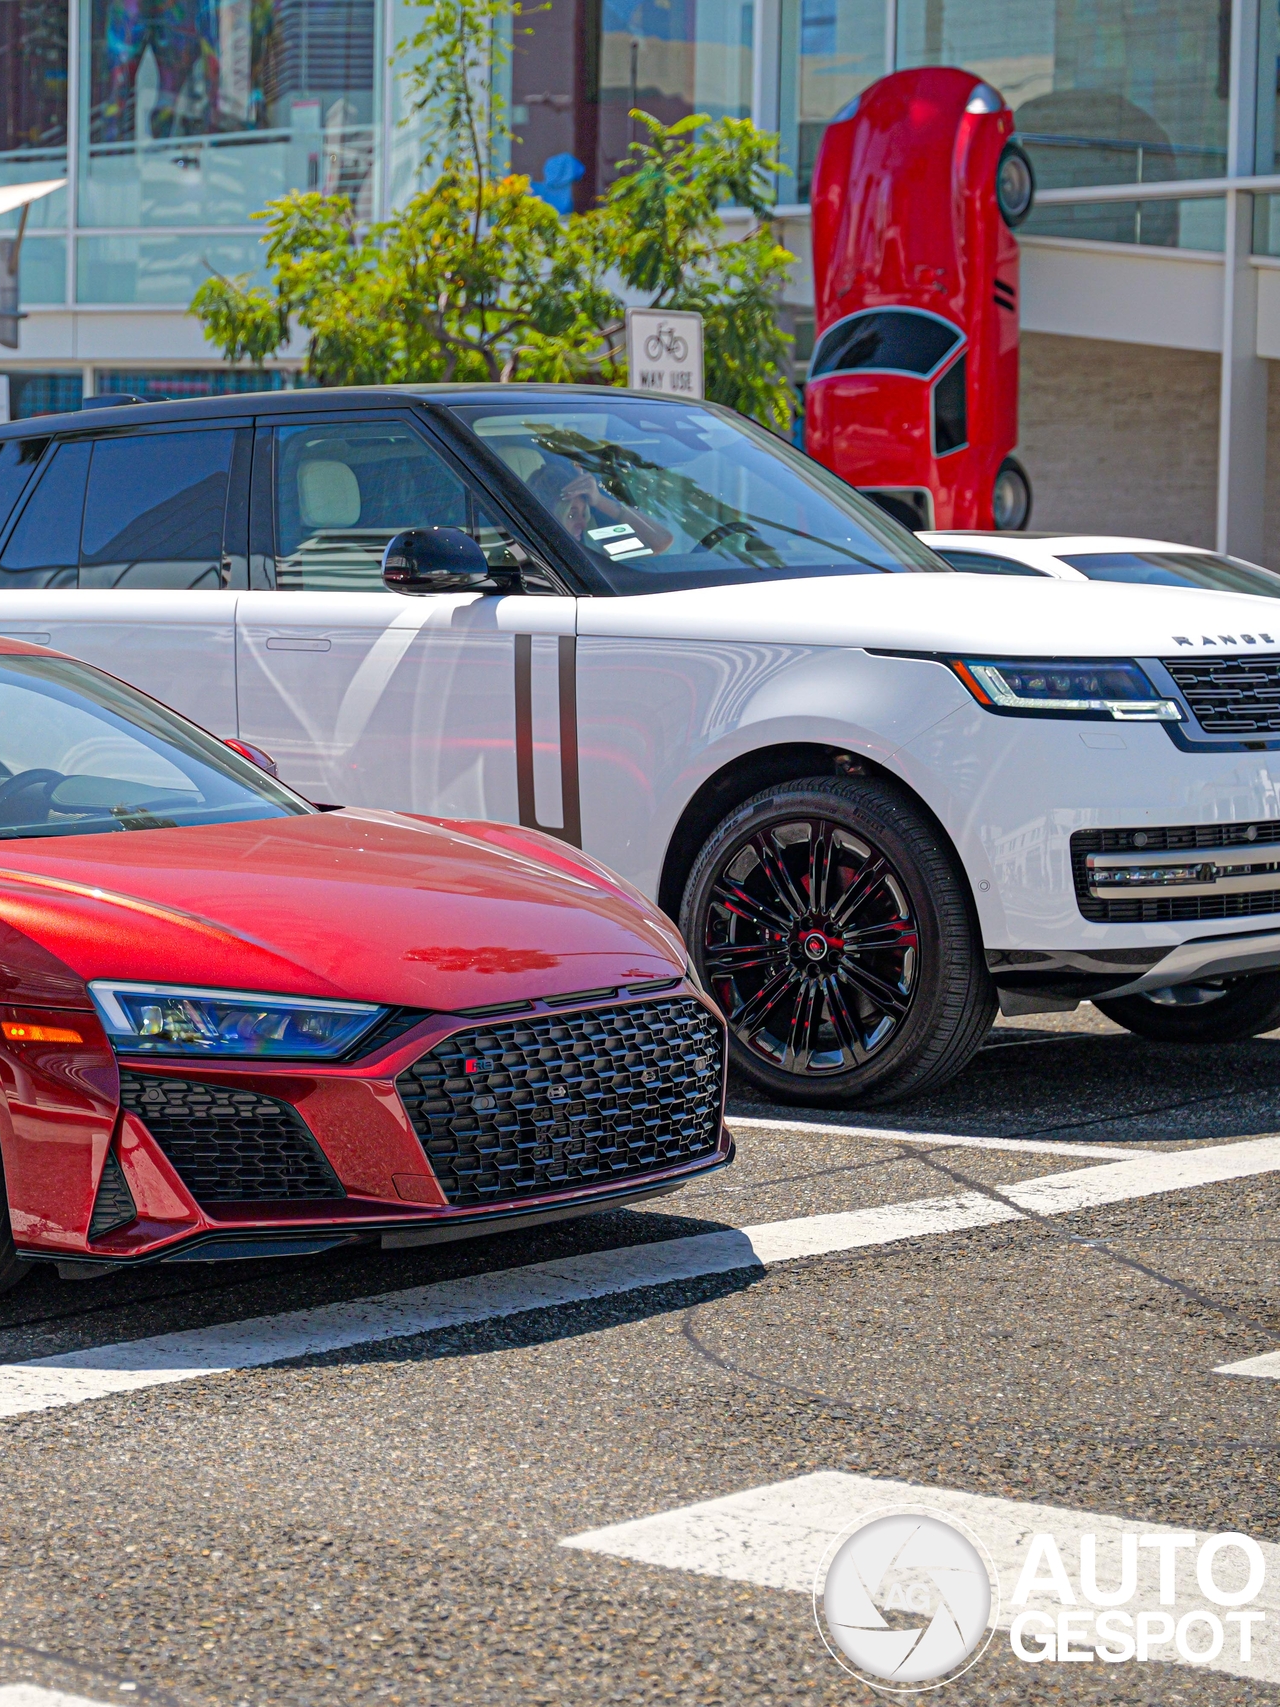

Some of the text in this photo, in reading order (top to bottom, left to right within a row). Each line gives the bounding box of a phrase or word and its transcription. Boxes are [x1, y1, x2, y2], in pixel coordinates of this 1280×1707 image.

[640, 370, 694, 391] MAY USE
[1171, 633, 1275, 646] RANGE
